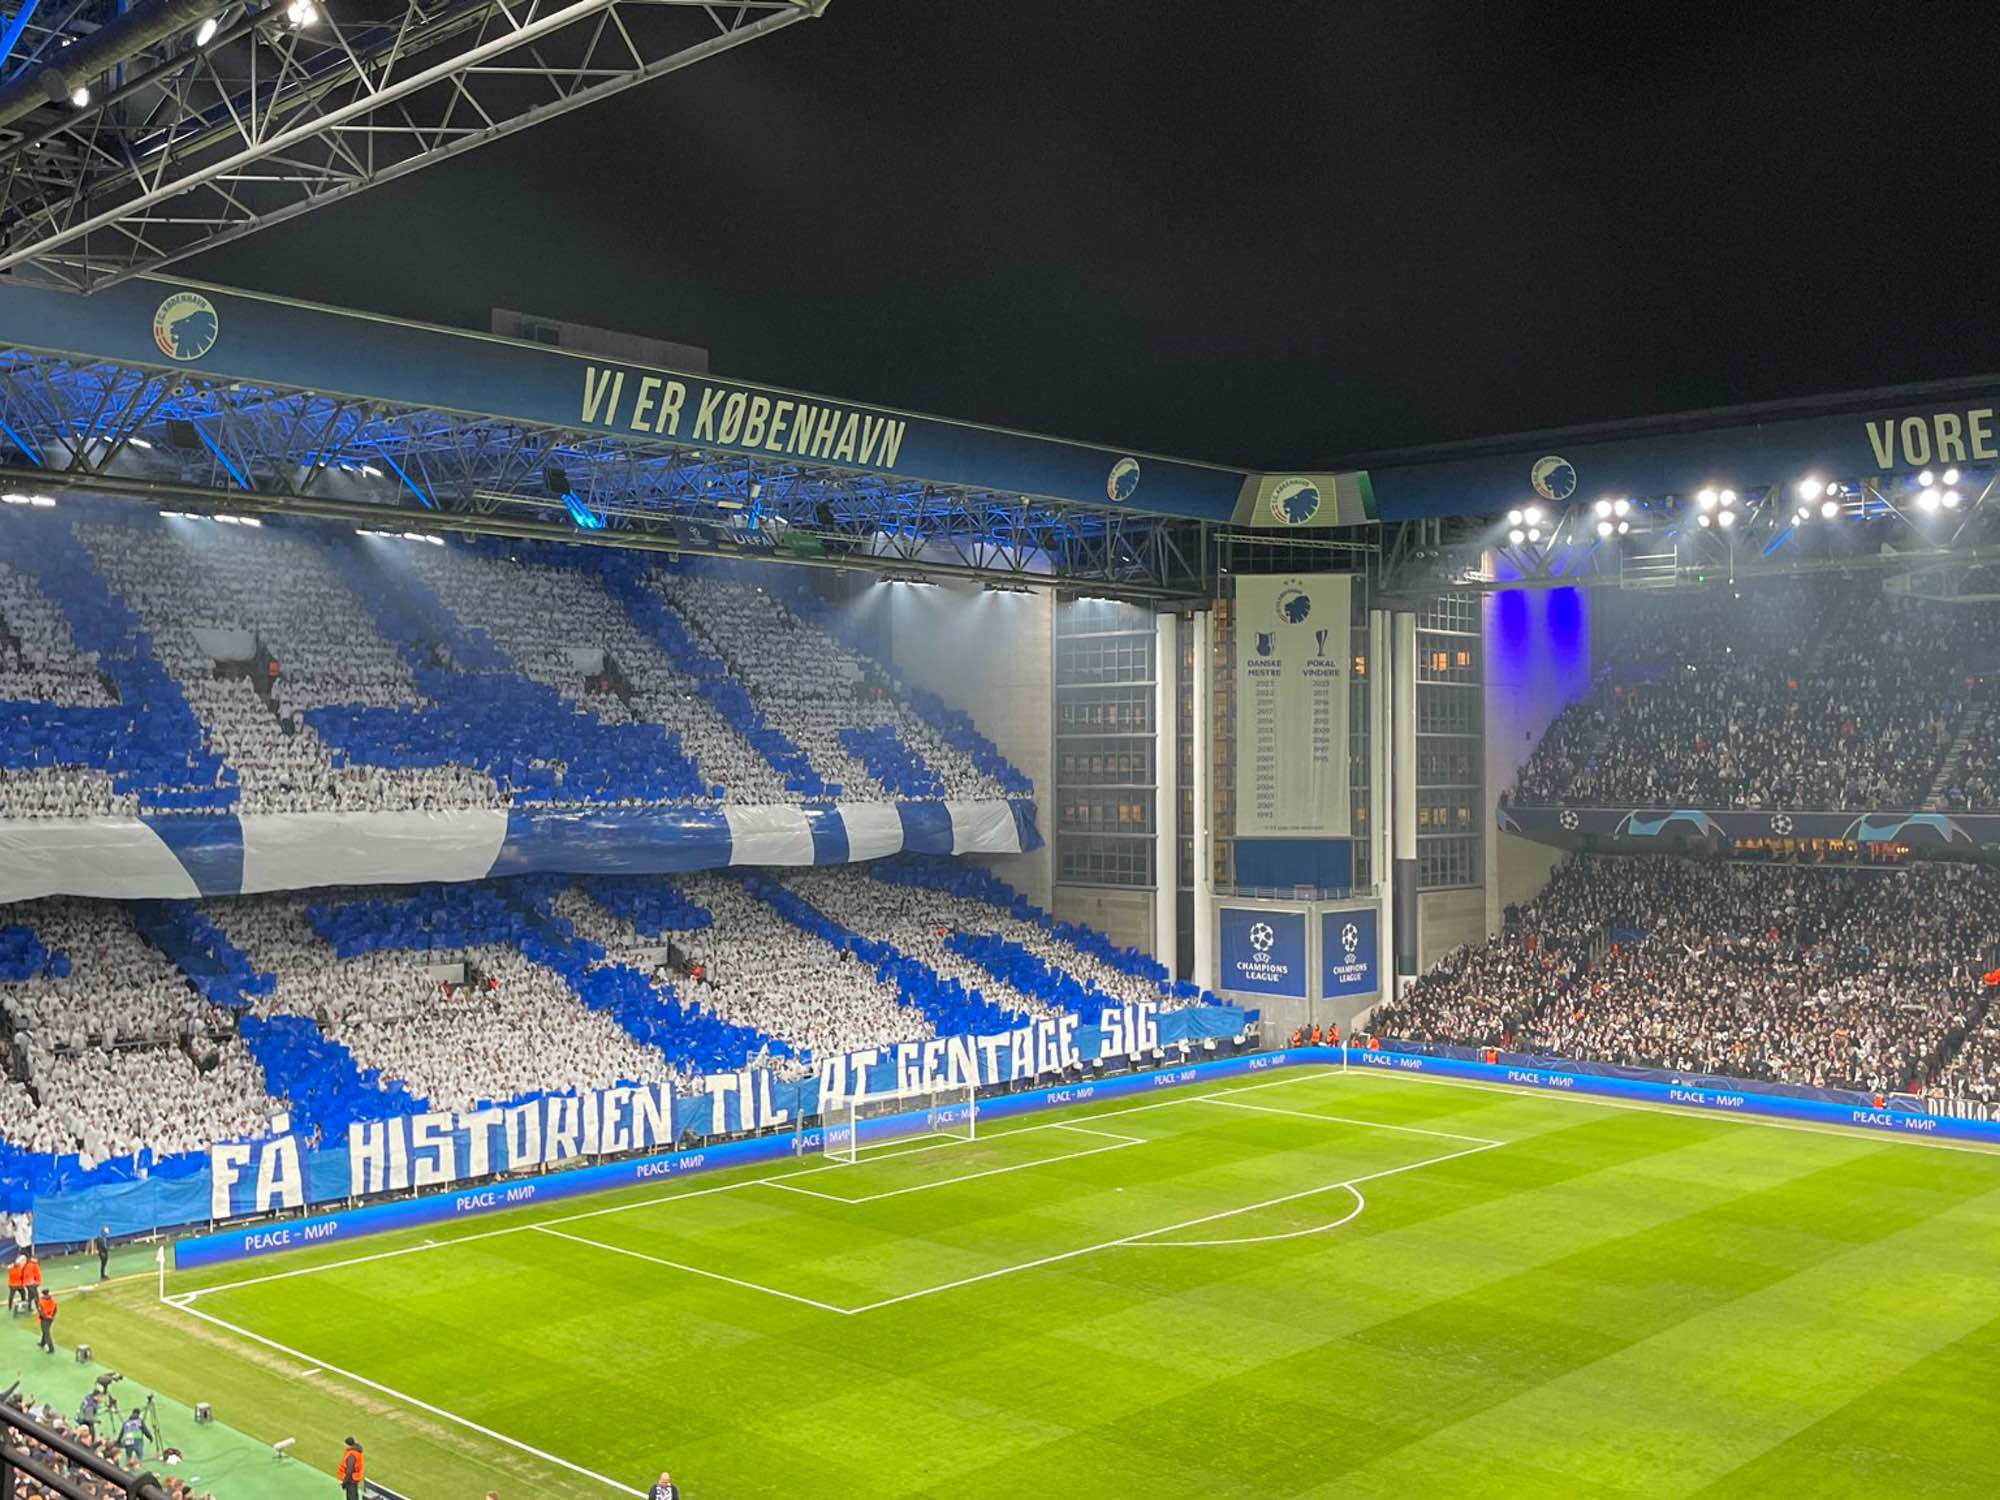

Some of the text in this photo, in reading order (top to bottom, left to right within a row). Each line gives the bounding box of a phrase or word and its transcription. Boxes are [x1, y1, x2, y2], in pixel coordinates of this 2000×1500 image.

[582, 366, 906, 469] VI ER KØBENHAVN
[1865, 408, 1999, 469] VORE
[1236, 961, 1288, 974] CHAMPIONS
[1245, 971, 1280, 982] LEAGUE
[1332, 963, 1368, 975] CHAMPIONS
[1363, 1053, 1392, 1066] PEACE
[1508, 1070, 1540, 1084] PEACE
[1549, 1075, 1575, 1087] МИР
[1670, 1089, 1705, 1104] PEACE
[1716, 1094, 1745, 1107] МИР
[211, 1112, 304, 1219] FÅ
[350, 1082, 672, 1197] HISTORIEN
[705, 1068, 788, 1134] TIL
[898, 1013, 1080, 1092] GENTAGE
[1101, 1002, 1159, 1058] SIG
[1852, 1111, 1893, 1127] PEACE
[1905, 1117, 1937, 1131] МИР
[636, 1160, 671, 1178] PEACE
[680, 1154, 705, 1170] МИР
[456, 1191, 496, 1211] PEACE
[506, 1184, 535, 1201] МИР
[244, 1229, 291, 1250] PEACE
[304, 1221, 338, 1240] МИР
